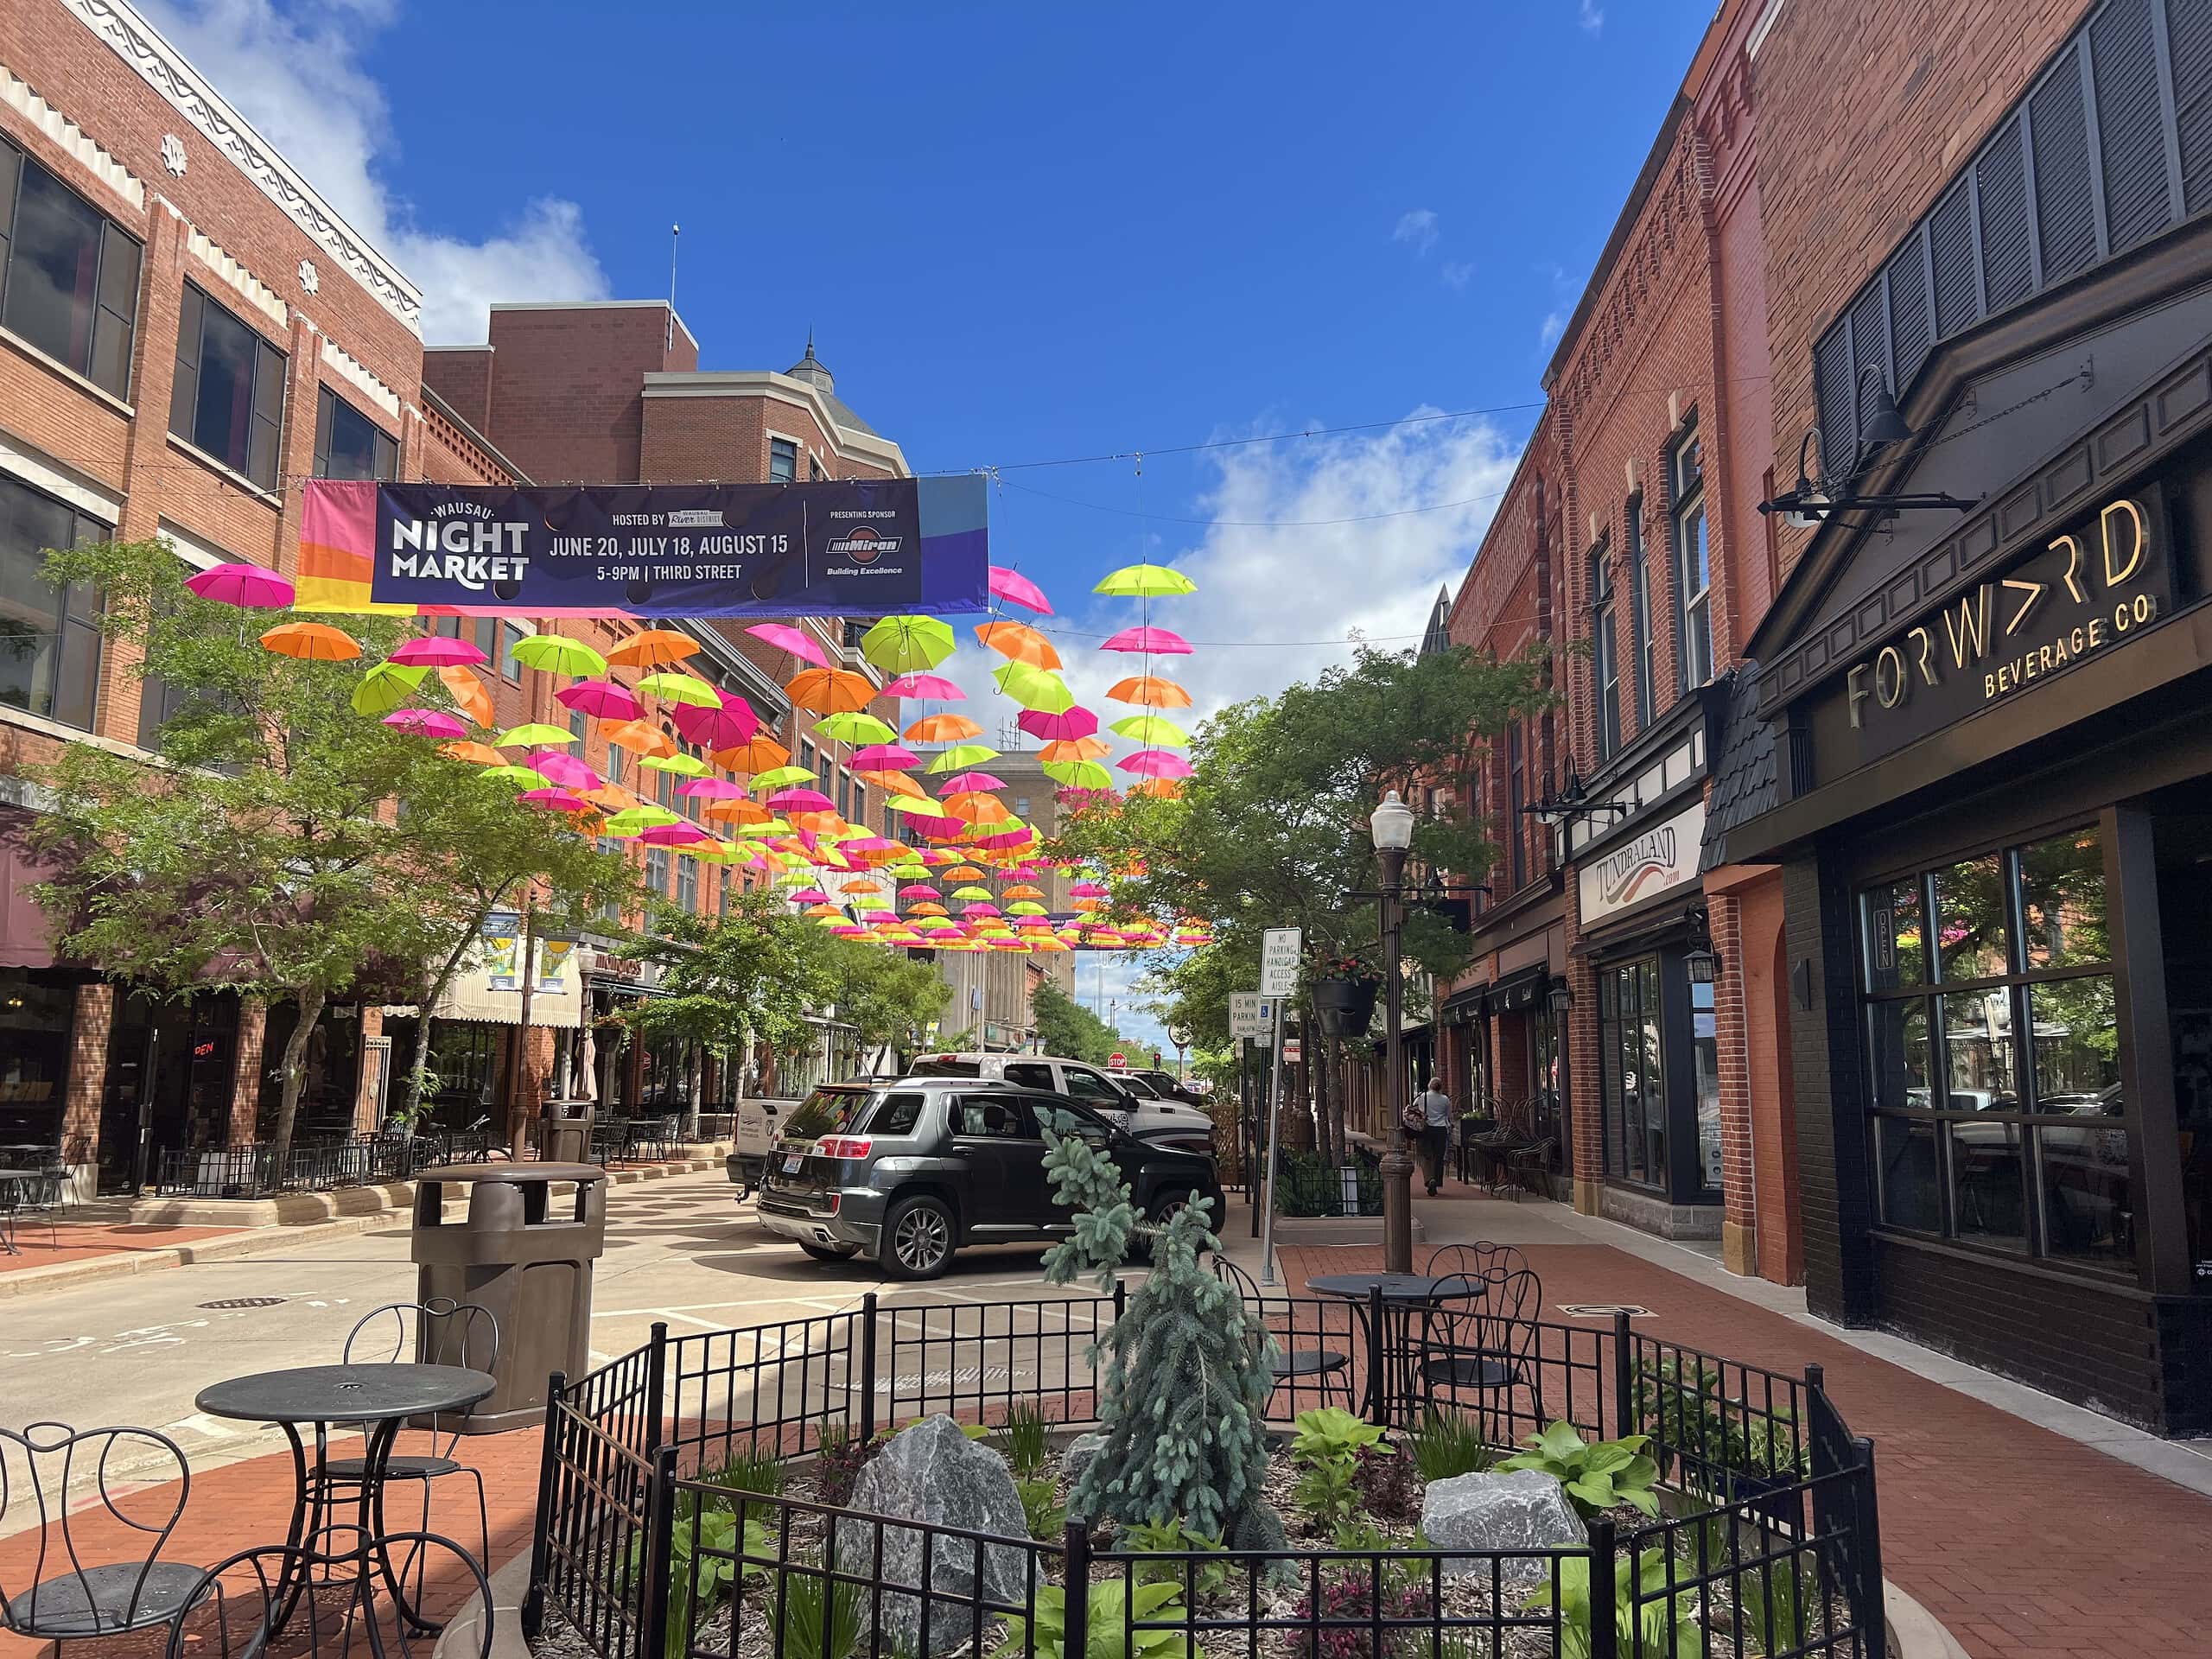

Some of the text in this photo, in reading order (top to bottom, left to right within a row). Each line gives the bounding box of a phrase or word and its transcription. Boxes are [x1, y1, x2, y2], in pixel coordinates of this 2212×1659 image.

[434, 501, 492, 519] WAUSAU
[830, 510, 896, 520] PRESENTING SPONSOR
[612, 513, 665, 527] HOSTED BY
[671, 515, 720, 524] River DISTRICT
[392, 518, 530, 555] NIGHT
[550, 533, 788, 560] JUNE 20, JULY 18, AUGUST 15
[849, 539, 897, 551] Miron
[391, 553, 531, 591] MARKET
[596, 564, 741, 582] 5-9PM THIRD STREET
[827, 567, 903, 576] Building Excellence
[1984, 594, 2151, 700] BEVERAGE CO
[1597, 827, 1676, 901] TUNDRALAND
[1664, 870, 1680, 886] .com
[1278, 933, 1287, 944] NO
[1879, 912, 1889, 967] OPEN
[1269, 945, 1294, 955] PARKING
[1267, 956, 1296, 966] HANDICAP
[1269, 969, 1292, 979] ACCESS
[1271, 981, 1287, 991] AISLE
[1235, 999, 1256, 1007] 15 MIN
[1232, 1012, 1255, 1021] PARKIN
[1109, 1058, 1125, 1066] STOP
